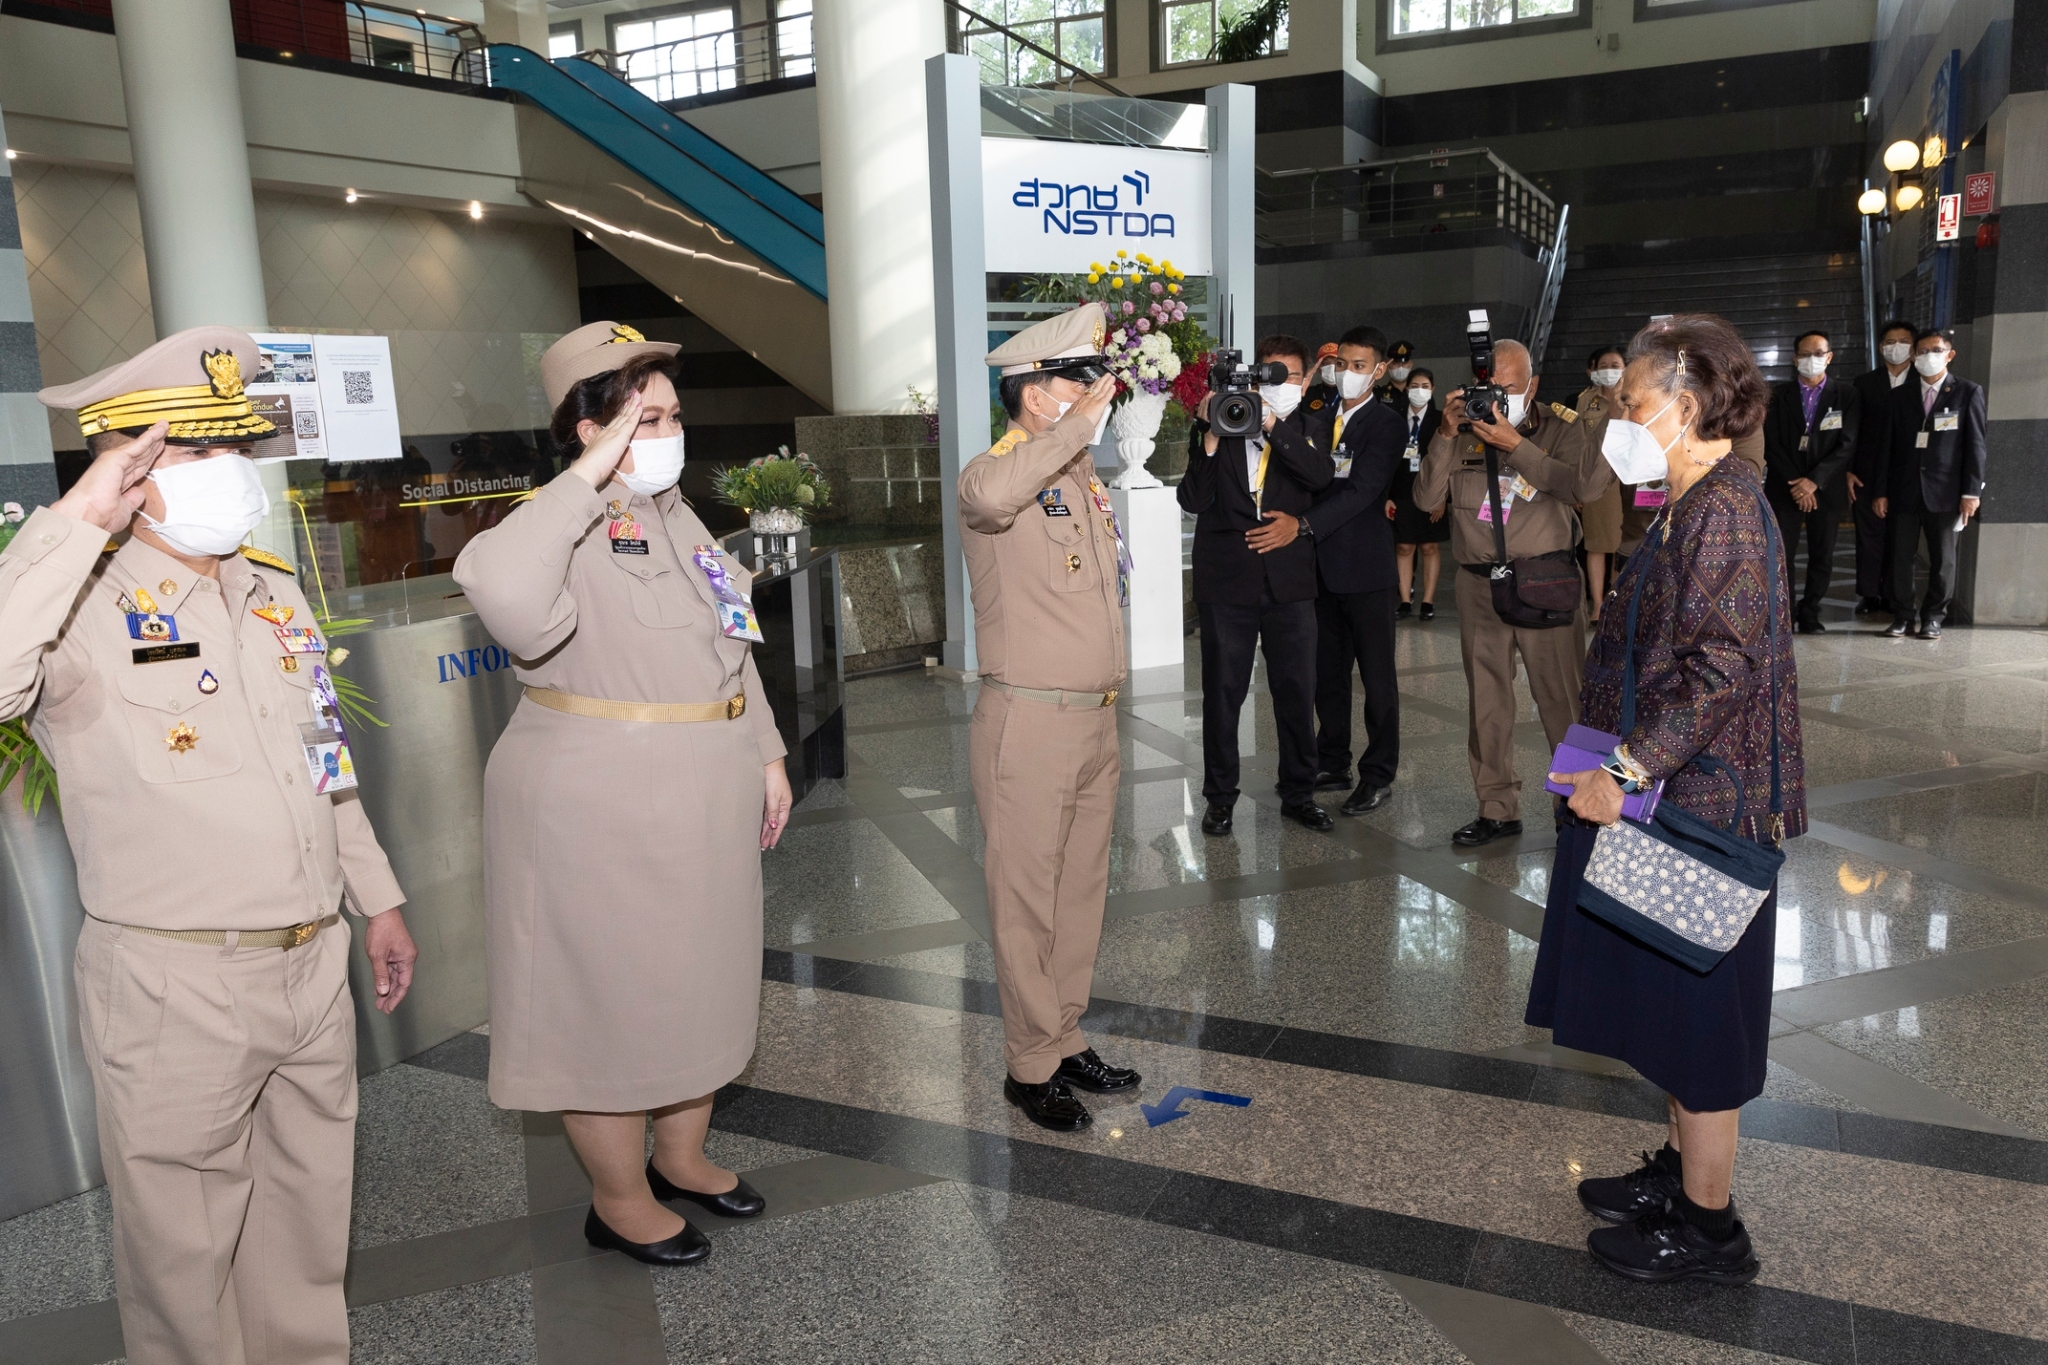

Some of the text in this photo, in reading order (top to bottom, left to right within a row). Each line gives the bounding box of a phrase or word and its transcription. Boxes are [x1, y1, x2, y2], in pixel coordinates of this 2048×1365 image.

[1043, 208, 1175, 238] NSTDA
[251, 403, 274, 411] ondue
[402, 474, 531, 500] Social Distancing
